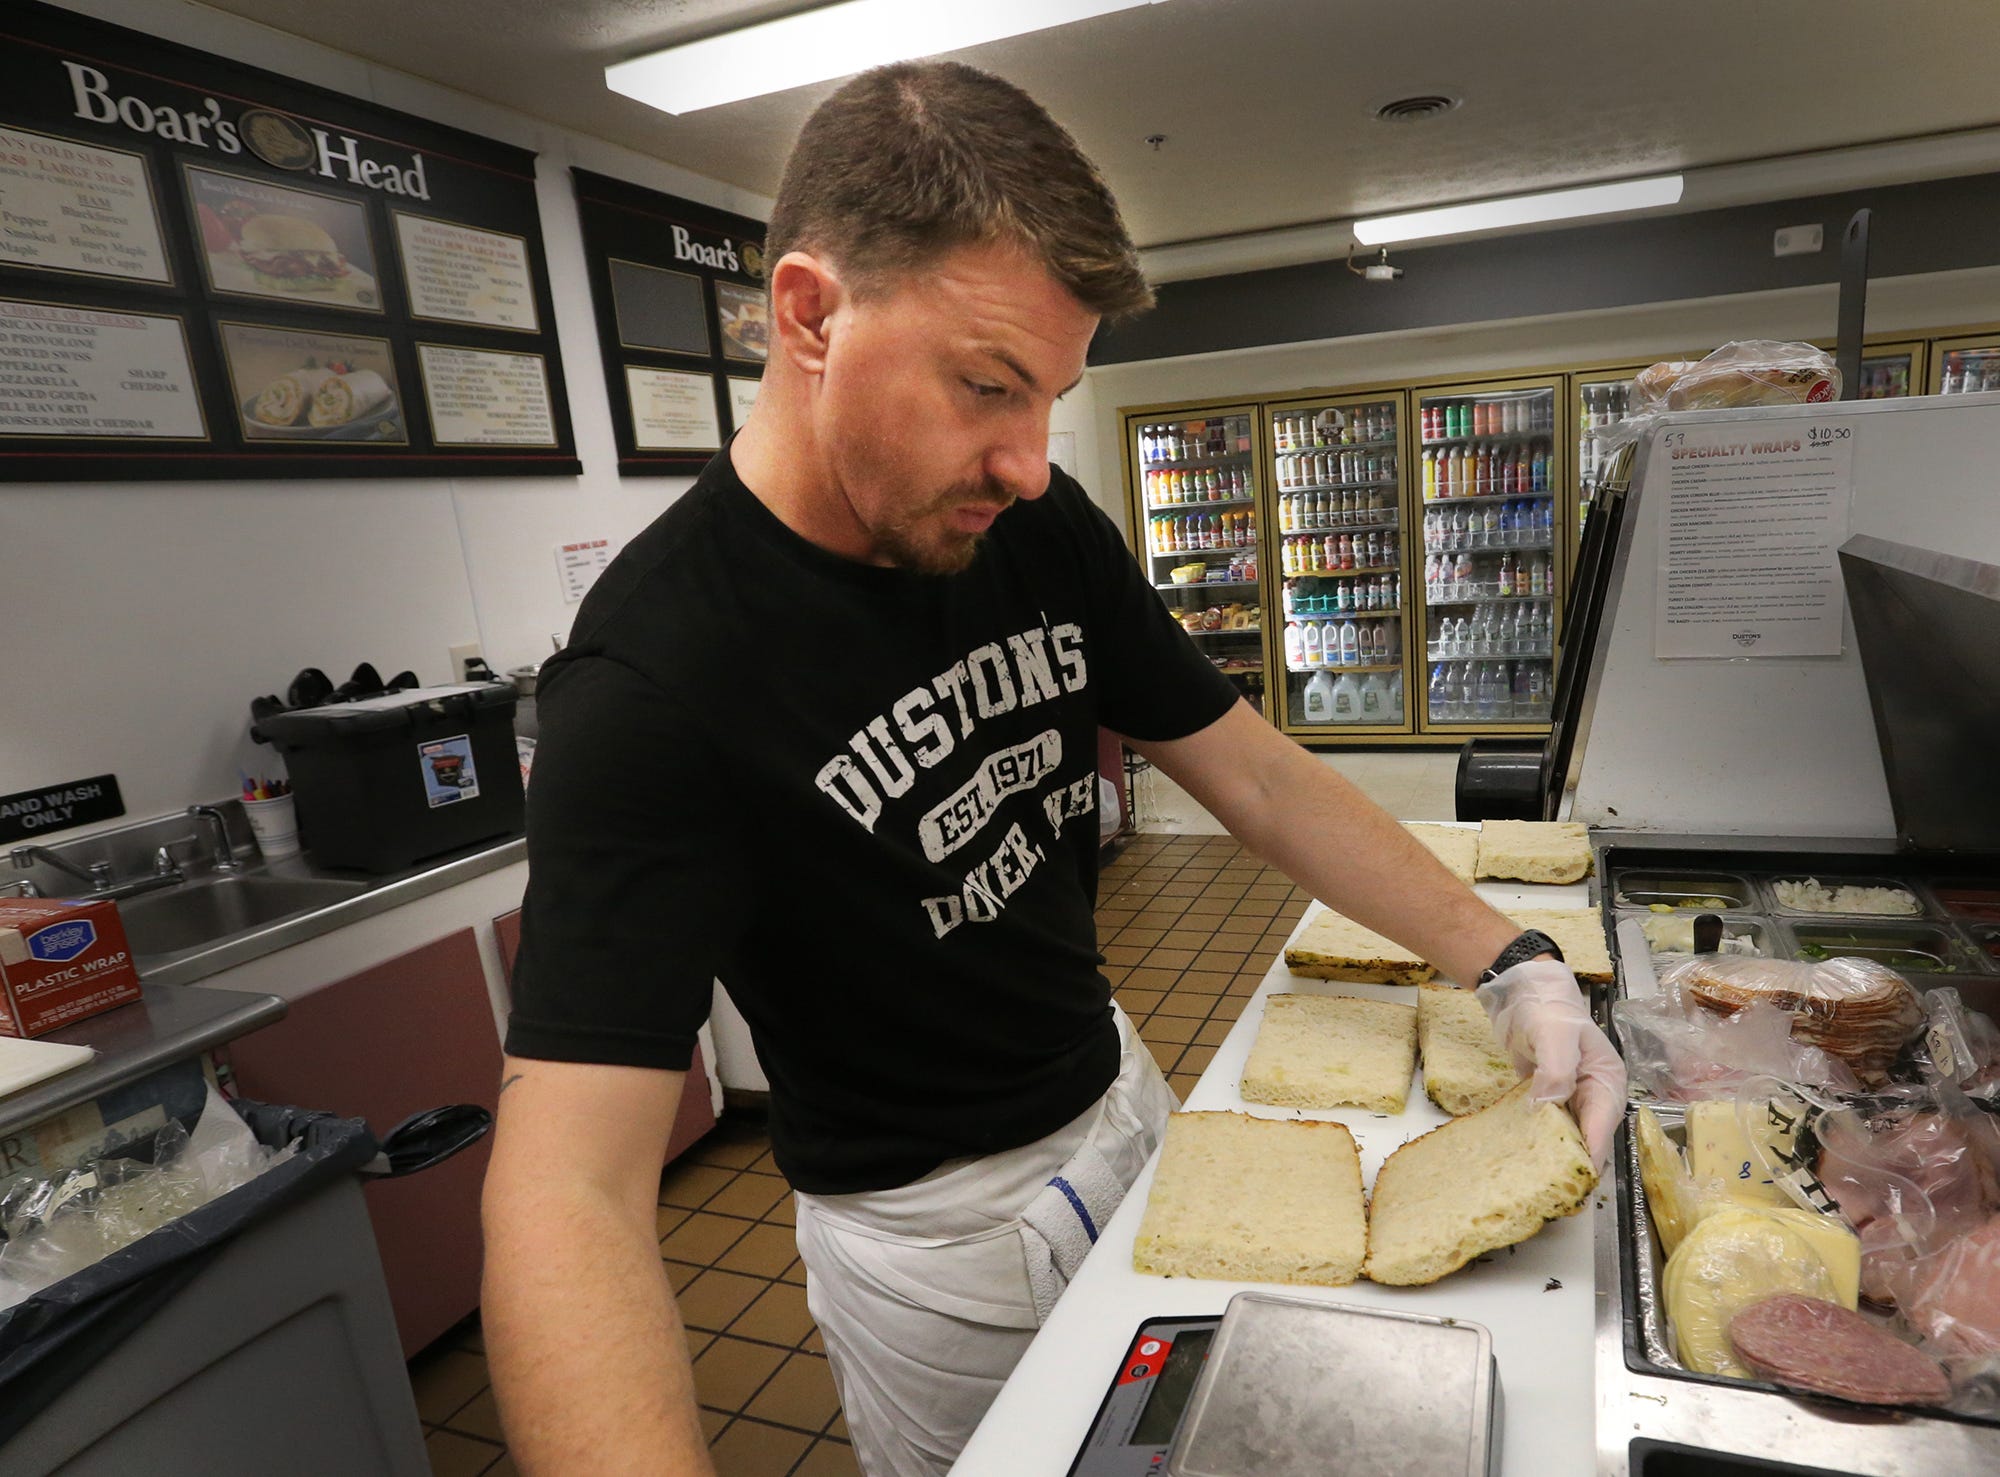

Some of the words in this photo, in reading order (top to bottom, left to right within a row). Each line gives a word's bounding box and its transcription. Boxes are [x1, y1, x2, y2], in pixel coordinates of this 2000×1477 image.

[62, 60, 241, 155] Boar's
[311, 128, 430, 201] Head
[671, 225, 739, 272] Boar's
[12, 333, 95, 350] PROVOLONE
[120, 381, 180, 394] CHEDDAR
[93, 417, 155, 430] CHEDDAR
[1807, 426, 1851, 441] $10.50
[1671, 444, 1748, 461] SPECIALTY
[1751, 439, 1801, 455] WRAPS
[988, 742, 1046, 796] 1971
[0, 797, 42, 819] AND
[44, 784, 102, 808] WASH
[21, 805, 74, 829] ONLY
[15, 966, 80, 996] PLASTIC
[82, 951, 127, 973] WRAP
